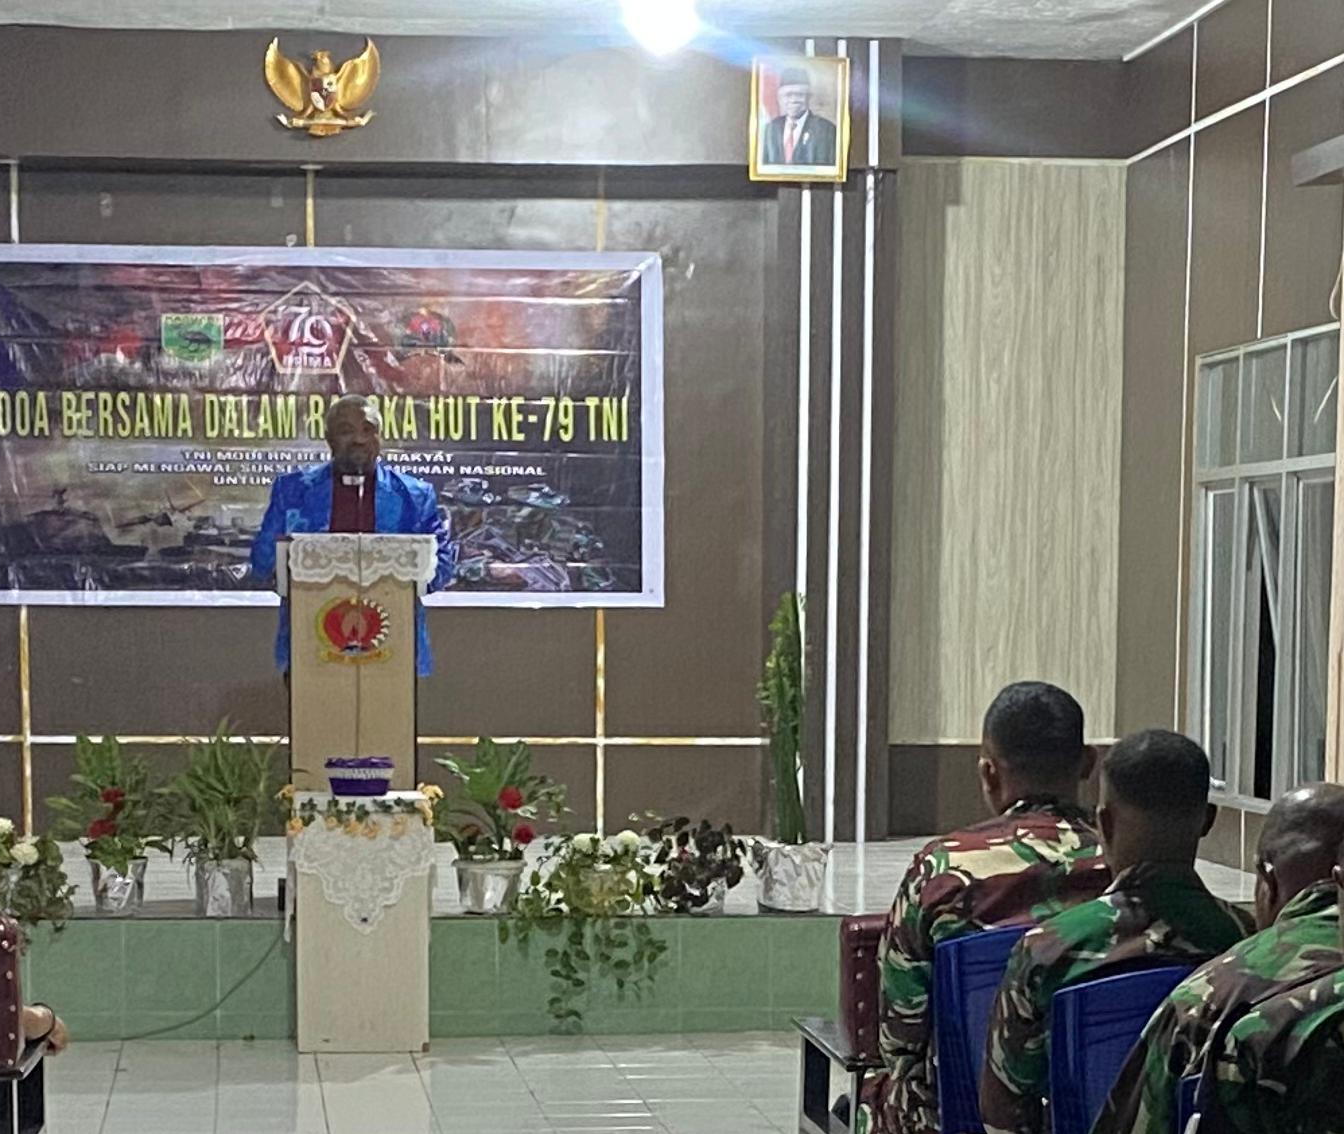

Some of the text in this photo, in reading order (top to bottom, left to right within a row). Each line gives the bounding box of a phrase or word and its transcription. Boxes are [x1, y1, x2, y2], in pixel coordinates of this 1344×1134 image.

[62, 391, 193, 438] BERSAMA
[205, 393, 296, 438] DALAM
[308, 394, 418, 440] RKA
[430, 395, 480, 440] HUT
[492, 396, 575, 441] KE-79
[586, 396, 629, 441] TNI
[183, 451, 211, 460] TNI
[217, 451, 292, 460] MODERN
[387, 452, 454, 463] RAKYAT
[133, 463, 230, 473] MENGAWAL
[459, 465, 548, 476] NASIONAL
[213, 475, 273, 486] UNTUK
